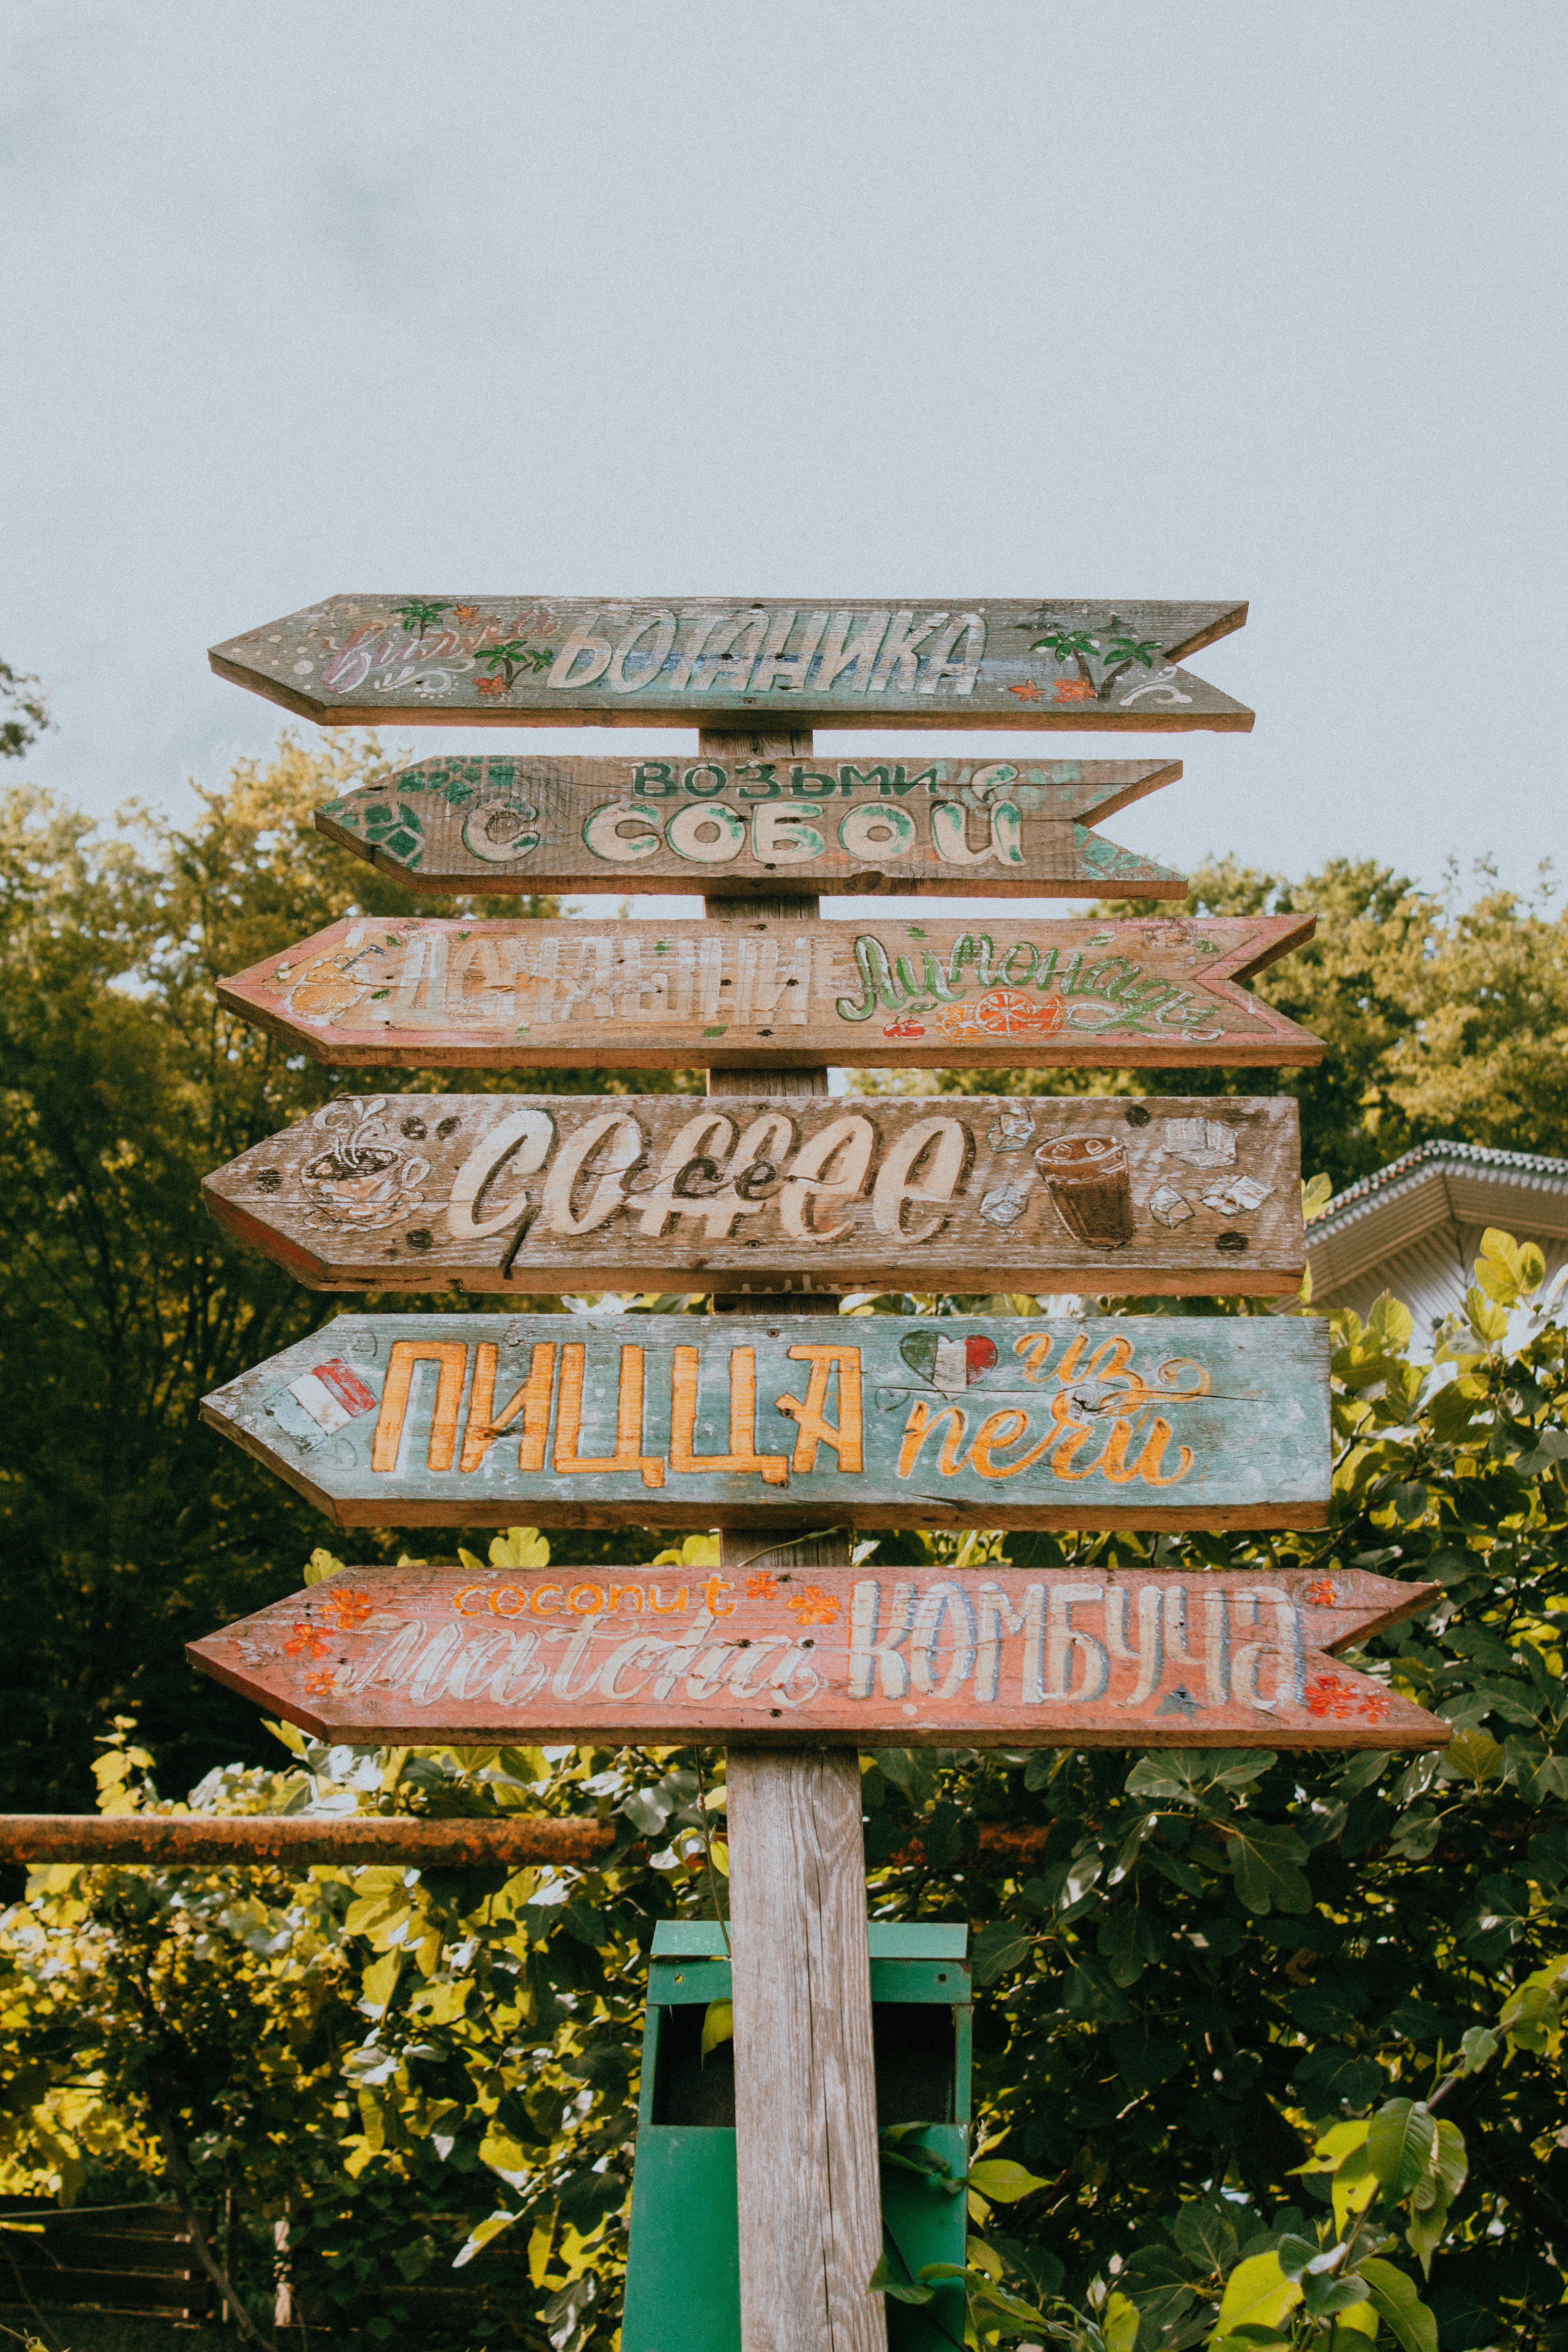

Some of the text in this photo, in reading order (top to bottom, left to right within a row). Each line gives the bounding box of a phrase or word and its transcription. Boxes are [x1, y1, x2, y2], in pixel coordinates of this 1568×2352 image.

[546, 607, 988, 694] БОТАНИКА
[460, 764, 1027, 866] С СОБОЙ
[632, 760, 939, 799] ВОЗЬМИ
[447, 1109, 976, 1245] COFFEE
[372, 1340, 863, 1488] ПИЦЦА
[1013, 1331, 1212, 1419] из
[897, 1392, 1194, 1485] печи
[452, 1573, 736, 1617] coconut
